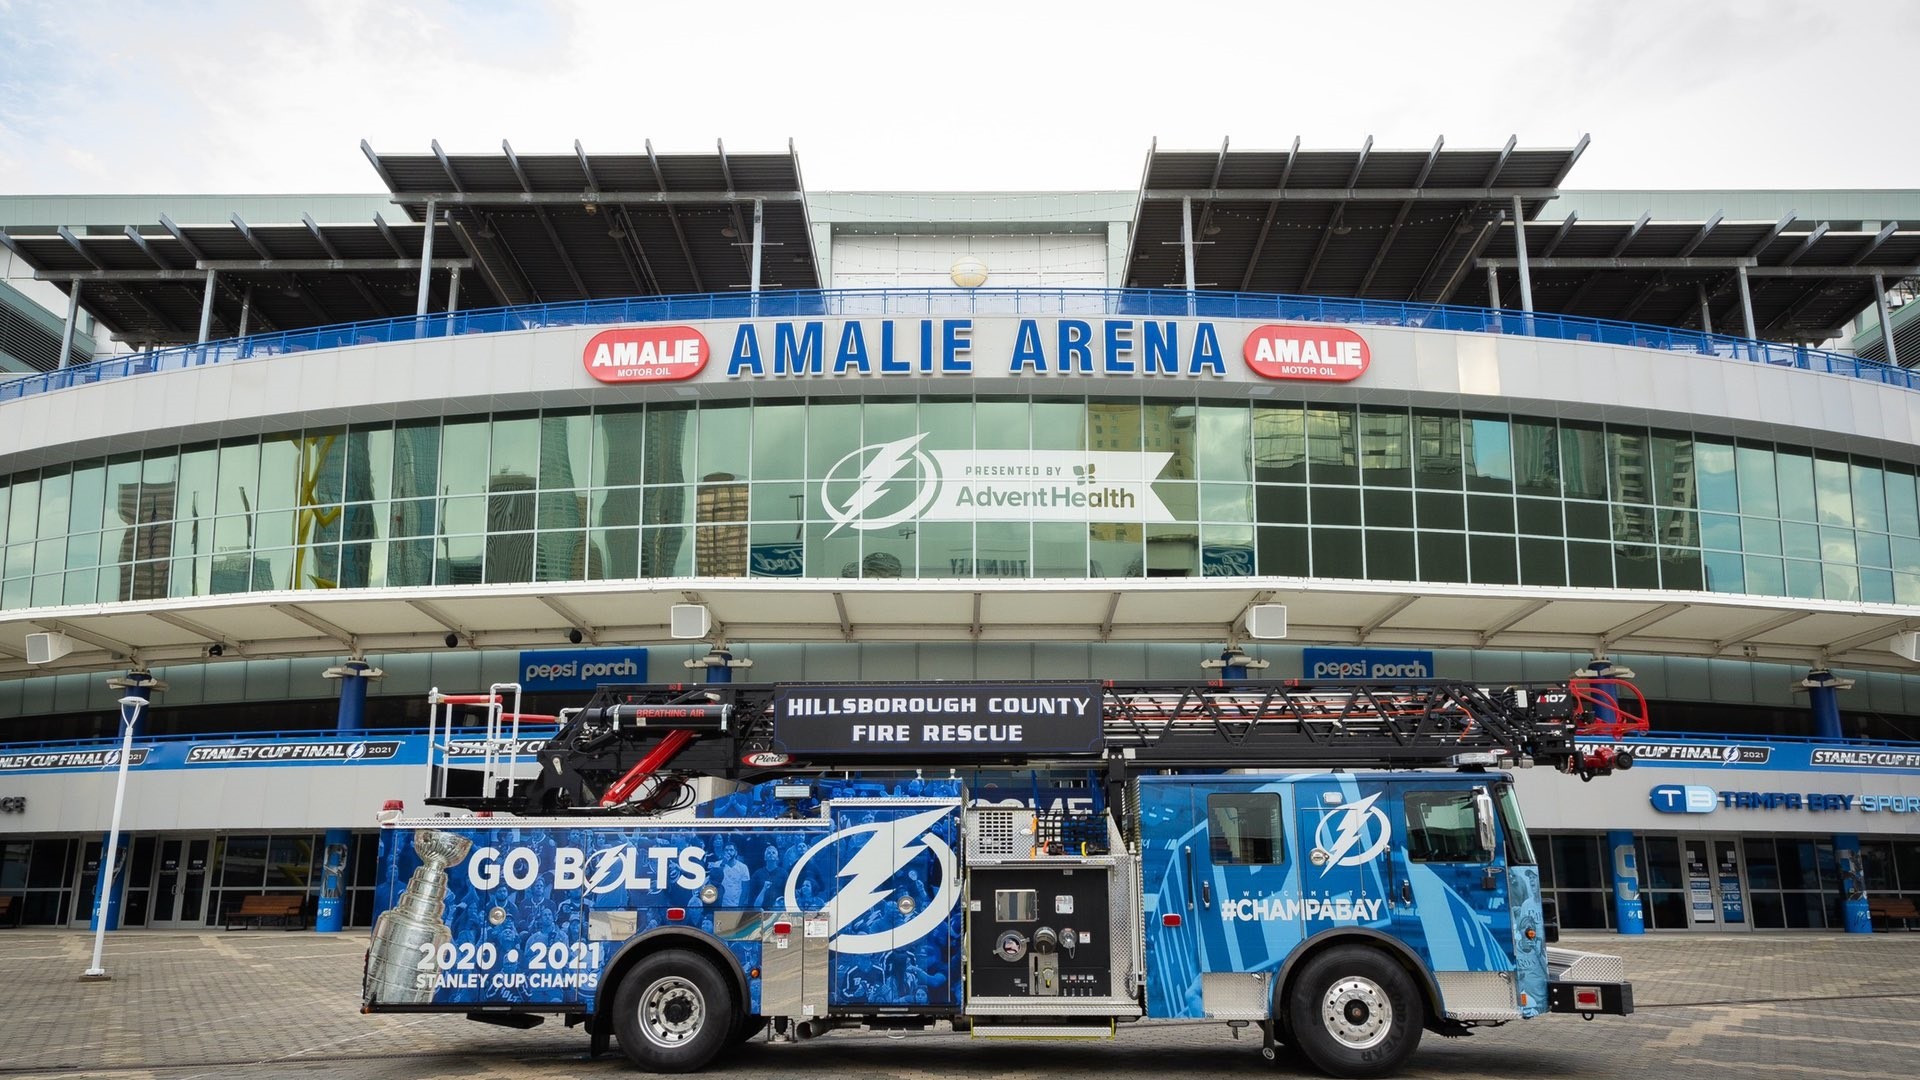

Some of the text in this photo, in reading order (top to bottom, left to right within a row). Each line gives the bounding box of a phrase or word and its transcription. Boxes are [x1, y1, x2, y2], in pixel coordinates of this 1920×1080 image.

[592, 339, 699, 367] AMALIE
[726, 319, 1228, 376] AMALIE ARENA
[1255, 338, 1362, 365] AMALIE
[618, 367, 671, 377] MOTOR OIL
[1282, 366, 1336, 376] MOTOR OIL
[965, 466, 1062, 476] PRESENTED BY
[956, 486, 1135, 508] AdventHealth
[526, 658, 637, 682] pepsi porch
[1313, 660, 1427, 679] pepsi porch
[636, 709, 705, 717] BREATHING AIR
[788, 697, 1090, 716] HILLSBOROUGH COUNTY
[852, 724, 1023, 742] FIRE RESCUE
[31, 755, 58, 767] CUP
[58, 752, 103, 765] FINAL
[190, 746, 260, 760] STANLEY
[258, 746, 290, 759] CUP
[291, 744, 345, 757] FINAL
[1635, 745, 1668, 757] CUP
[1670, 746, 1721, 759] FINAL
[1814, 751, 1876, 764] STANLEY
[1876, 754, 1904, 765] CUP
[1719, 791, 1804, 810] TAMPA
[1807, 793, 1855, 811] BAY
[468, 843, 706, 897] GO BOLTS
[1221, 898, 1382, 921] #CHAMPABAY
[417, 942, 599, 970] 2020 2021
[416, 973, 598, 989] STANLEY CUP CHAMPS
